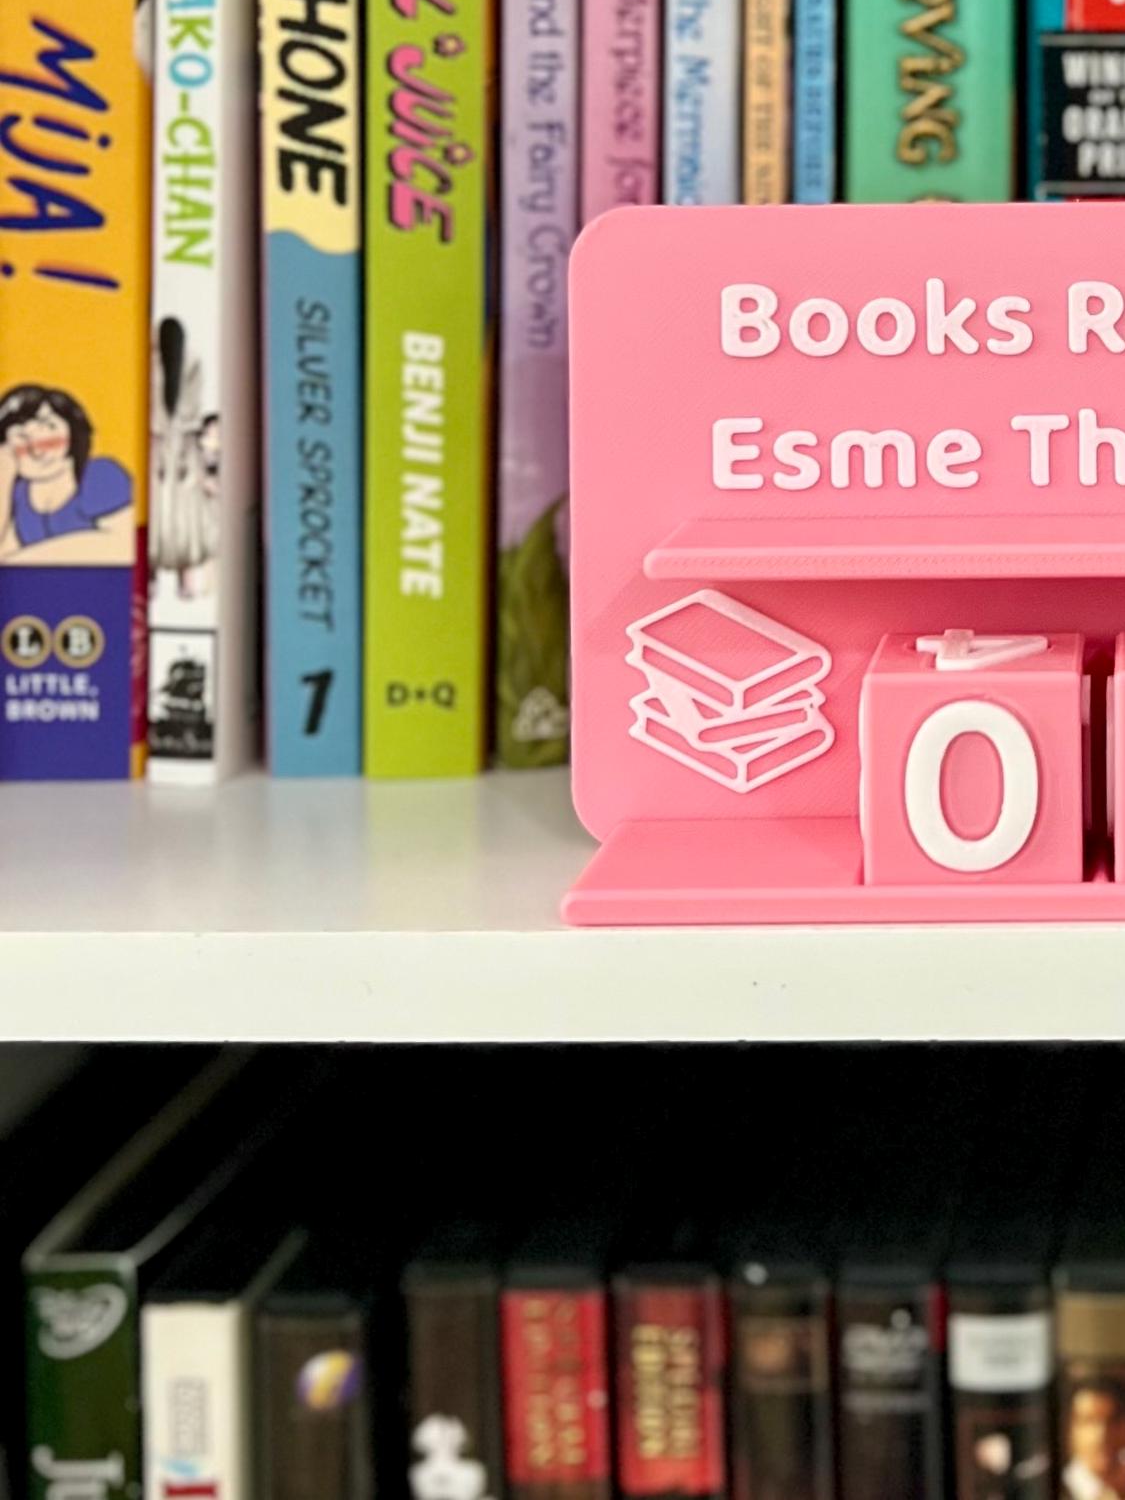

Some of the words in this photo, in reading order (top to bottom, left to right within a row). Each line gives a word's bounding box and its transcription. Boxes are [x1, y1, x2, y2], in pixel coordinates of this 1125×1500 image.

[524, 48, 568, 106] the
[520, 118, 568, 214] Fairy
[524, 224, 568, 350] Crown
[719, 279, 1034, 359] Books
[297, 299, 330, 425] SILVER
[400, 331, 444, 463] BENJI
[711, 416, 980, 491] Esme
[299, 439, 334, 631] SPROCKET
[400, 474, 444, 599] NATE
[6, 700, 99, 721] BROWN
[301, 669, 333, 736] 1
